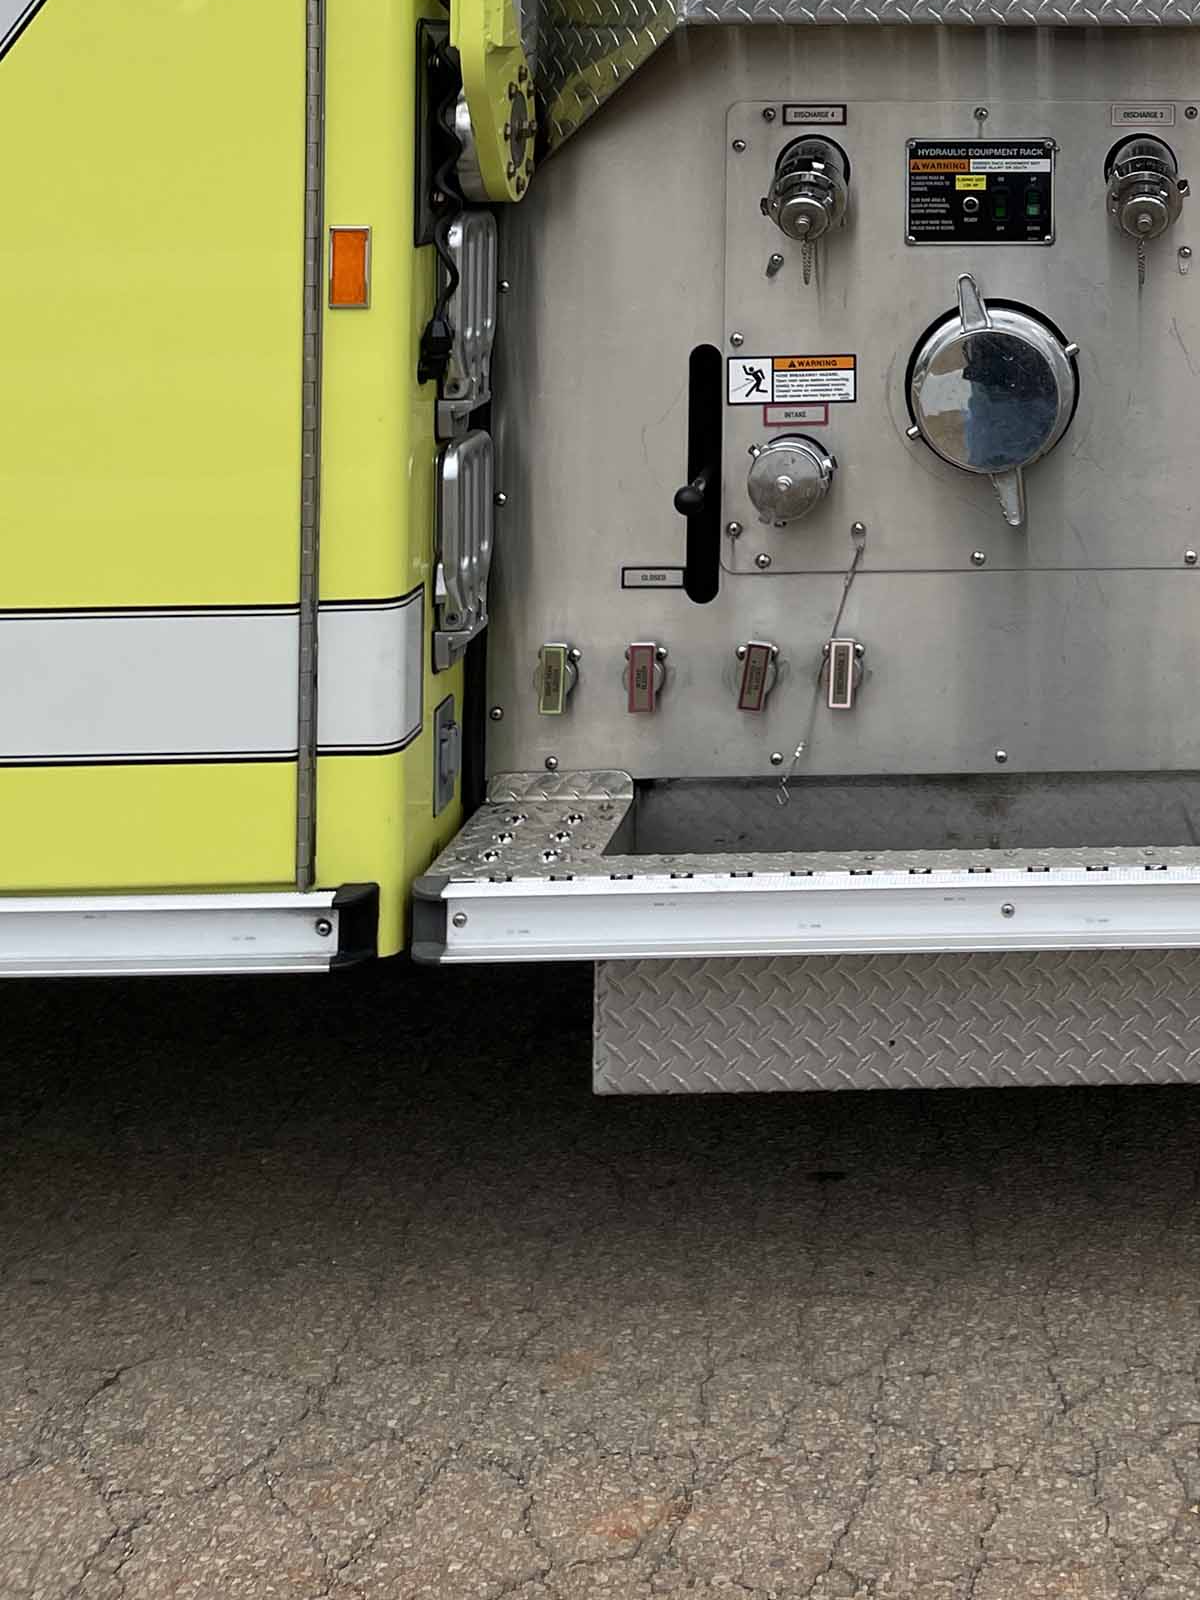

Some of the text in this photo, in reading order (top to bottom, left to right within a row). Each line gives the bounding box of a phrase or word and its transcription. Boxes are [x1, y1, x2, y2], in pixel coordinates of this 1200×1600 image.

[918, 148, 1044, 157] HYDRAULIC EQUIPMENT RACK
[921, 161, 967, 171] WARNING
[797, 359, 838, 368] WARNING
